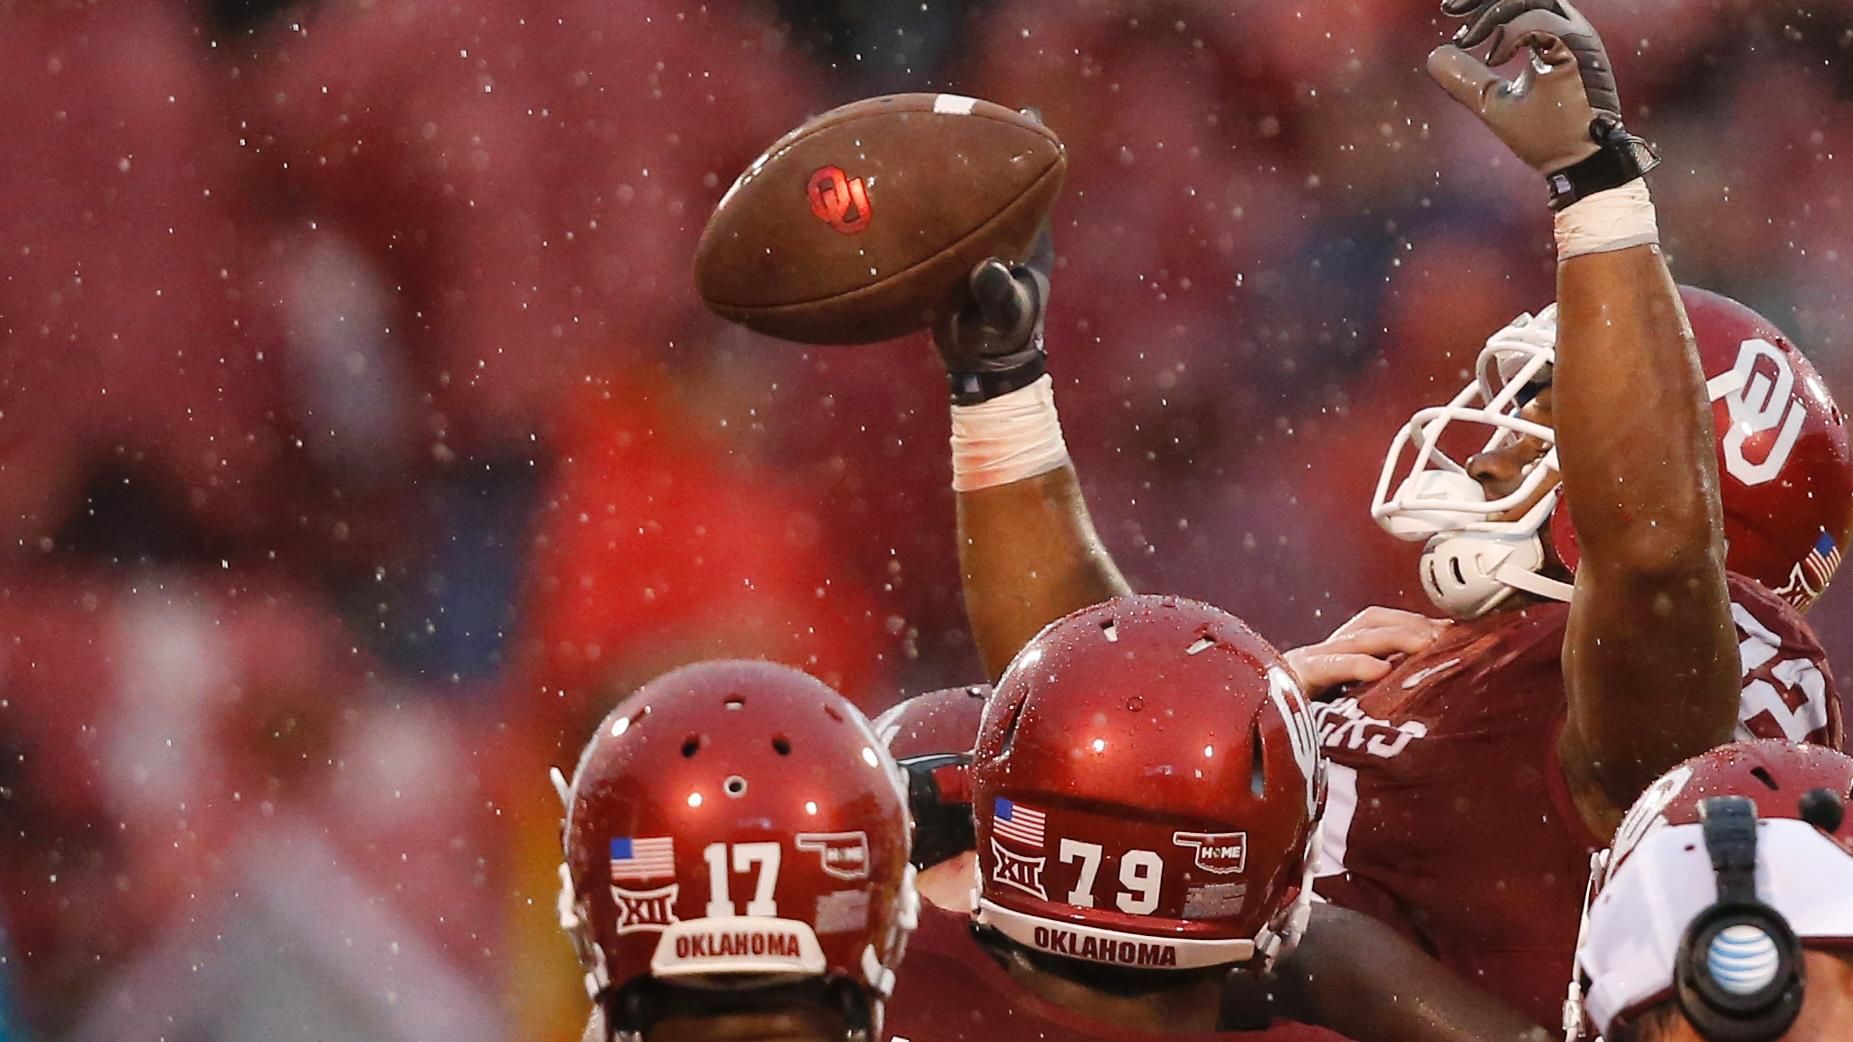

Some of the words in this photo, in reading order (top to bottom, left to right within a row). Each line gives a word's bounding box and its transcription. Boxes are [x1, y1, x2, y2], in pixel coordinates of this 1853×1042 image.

[704, 842, 781, 917] 17
[1060, 838, 1164, 915] 79
[676, 932, 800, 958] OKLAHOMA
[1034, 926, 1177, 966] OKLAHOMA
